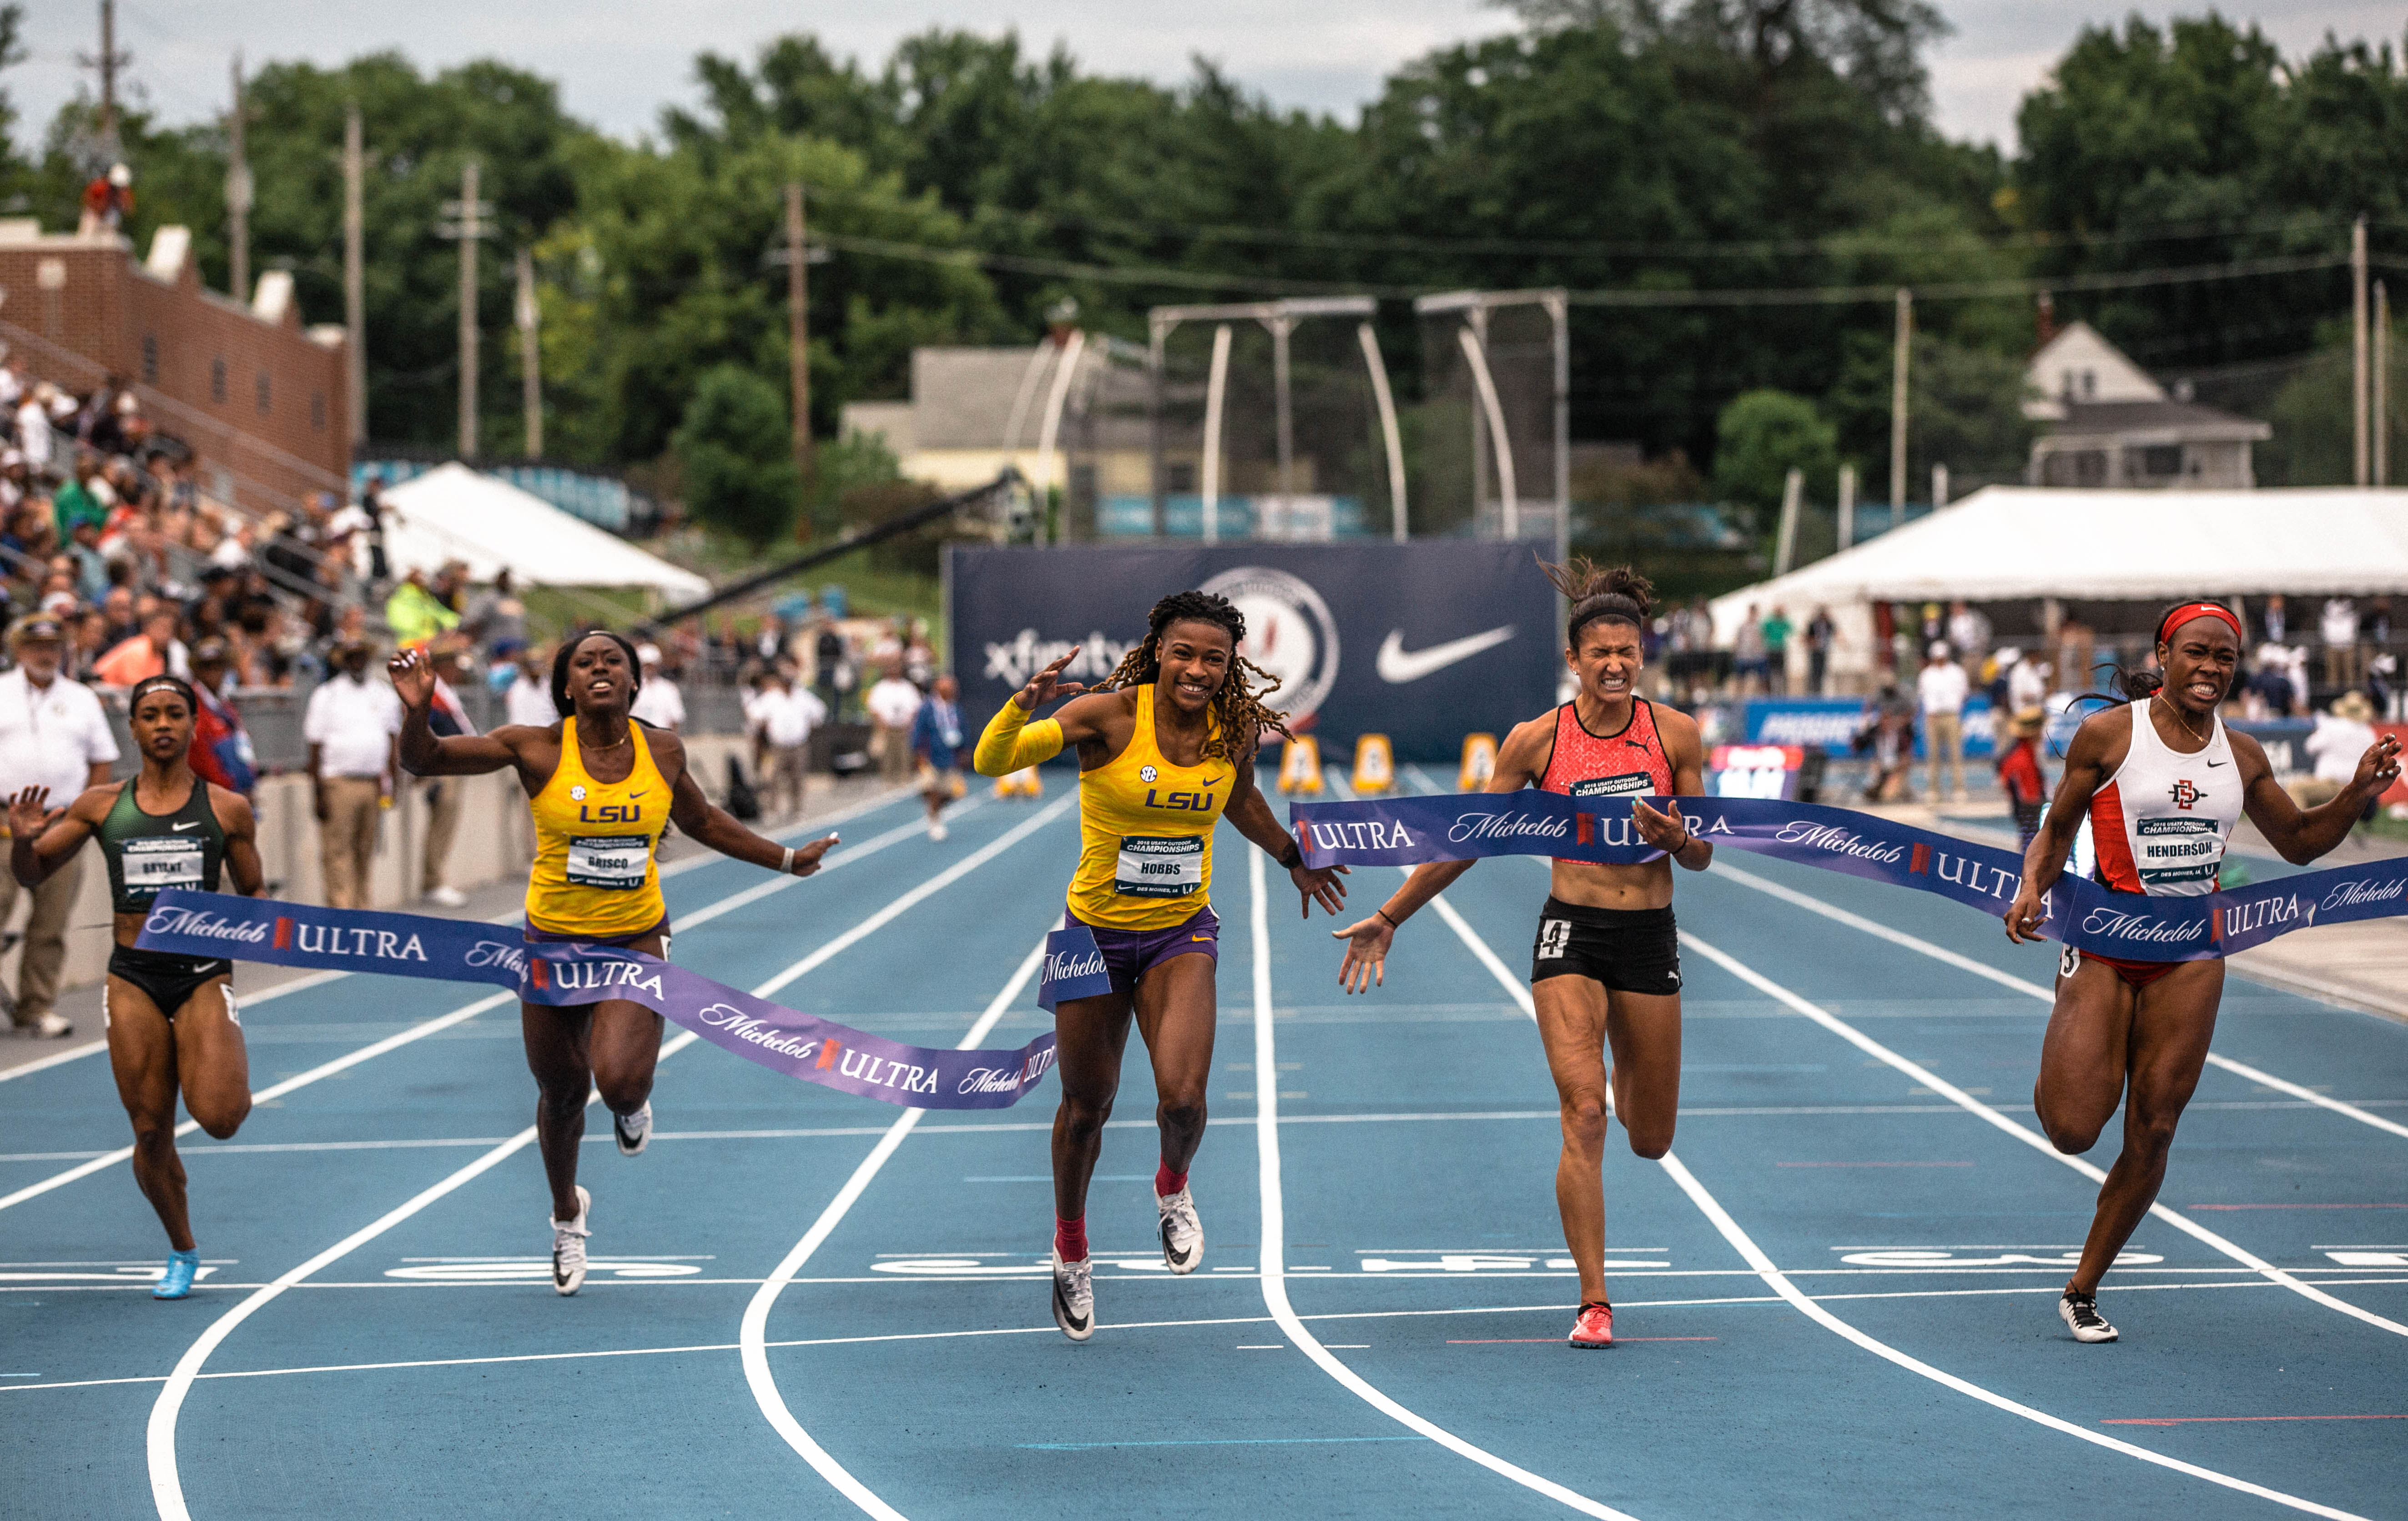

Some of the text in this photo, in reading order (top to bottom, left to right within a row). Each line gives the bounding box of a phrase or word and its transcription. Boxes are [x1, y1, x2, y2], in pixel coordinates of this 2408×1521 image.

[1141, 766, 1157, 782] SEC
[1614, 776, 1638, 785] OUTDOOR
[1145, 789, 1214, 811] LSU
[1575, 779, 1648, 796] CHAMPIONSHIPS
[580, 805, 640, 823] LSU
[1311, 818, 1415, 850] ULTRA
[1448, 811, 1735, 847] Michelob URA
[1127, 844, 1200, 853] CHAMPIONSHIPS
[1775, 821, 1905, 863] Michelob
[2147, 841, 2213, 858] HENDERSON
[588, 856, 629, 869] BRISCO
[1140, 862, 1181, 875] HOBBS
[2082, 877, 2408, 942] Michelob ULTRA Michelob
[146, 906, 428, 962] Michelob ULTRA
[1542, 922, 1562, 956] 4
[2064, 946, 2074, 974] 3
[553, 962, 665, 1001] ULTRA
[699, 1003, 818, 1059] Michelob
[840, 1048, 939, 1094] ULTRA
